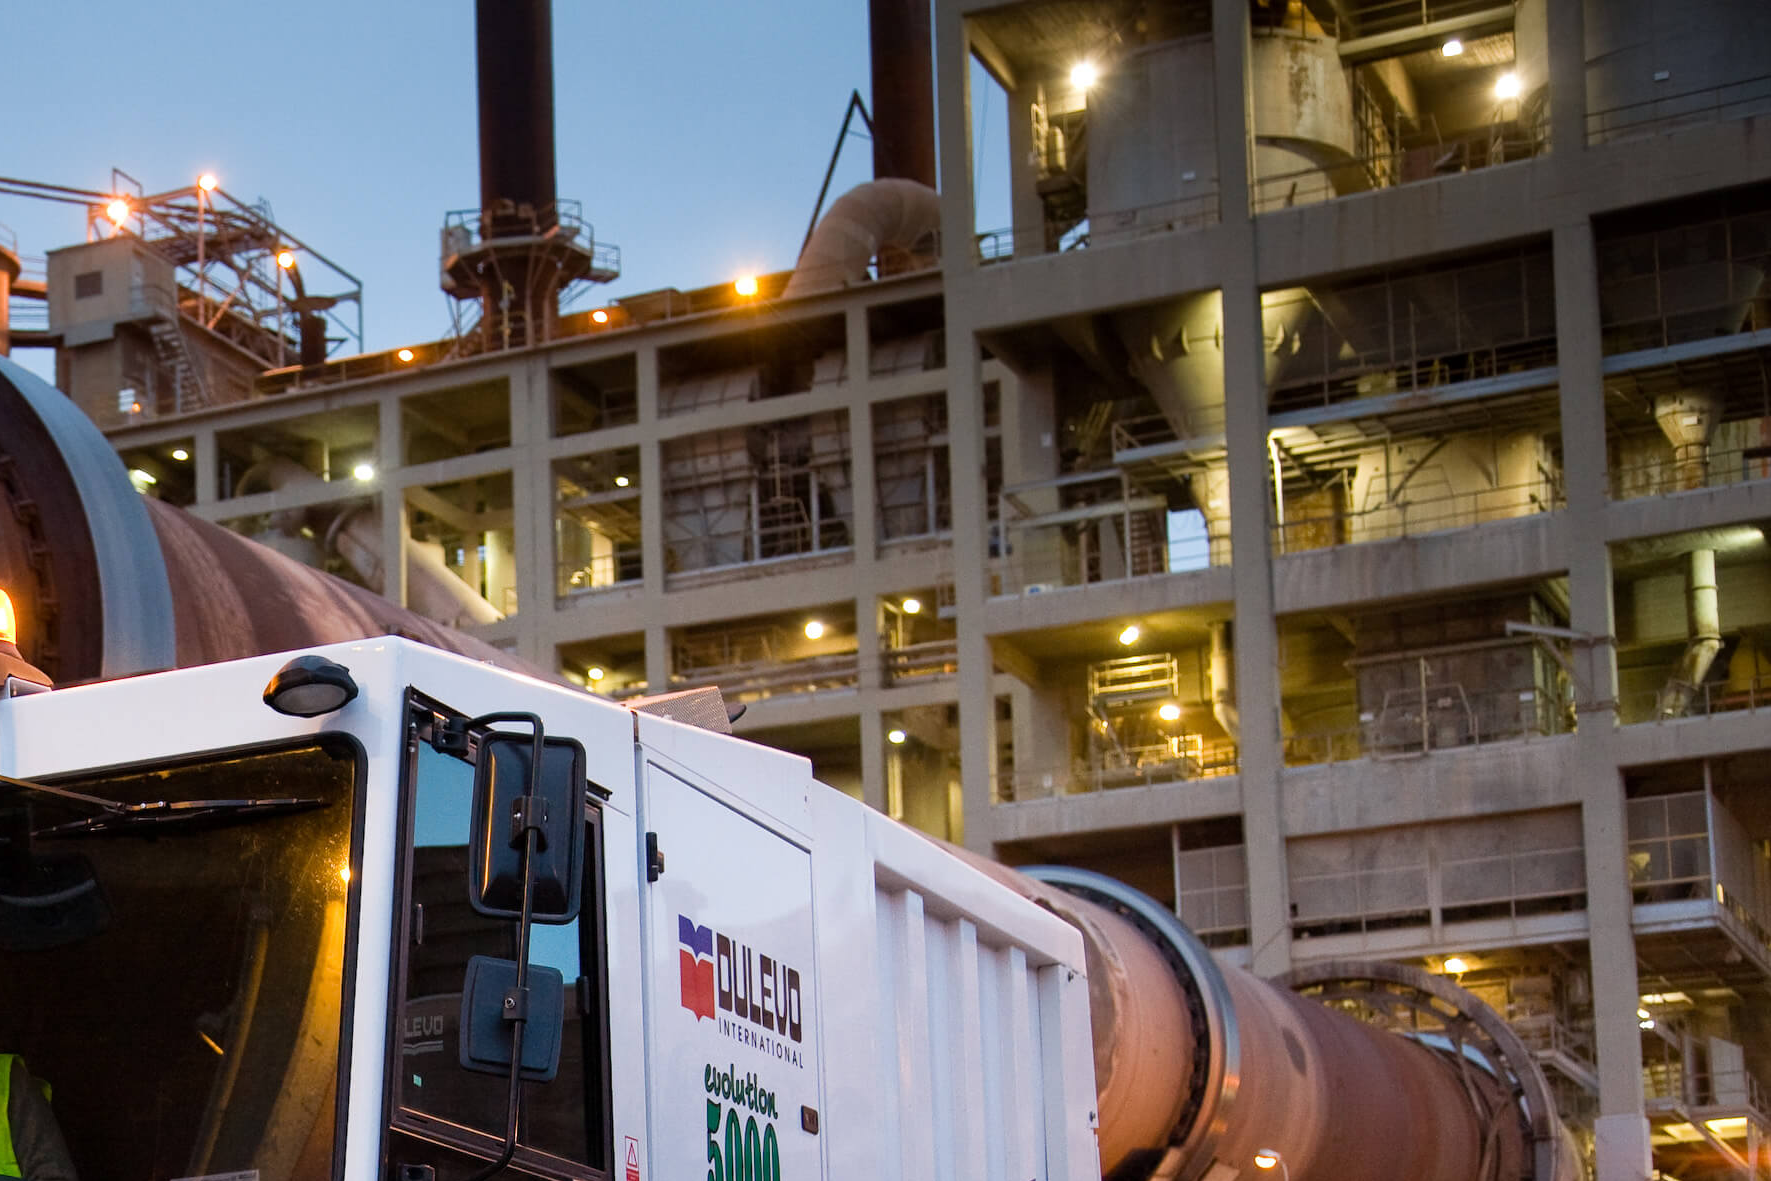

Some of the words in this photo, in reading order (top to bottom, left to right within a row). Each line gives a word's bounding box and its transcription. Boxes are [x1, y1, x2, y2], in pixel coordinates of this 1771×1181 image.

[716, 932, 802, 1044] DULEVO
[718, 1016, 804, 1069] INTERNATIONAL
[704, 1063, 778, 1120] evolution
